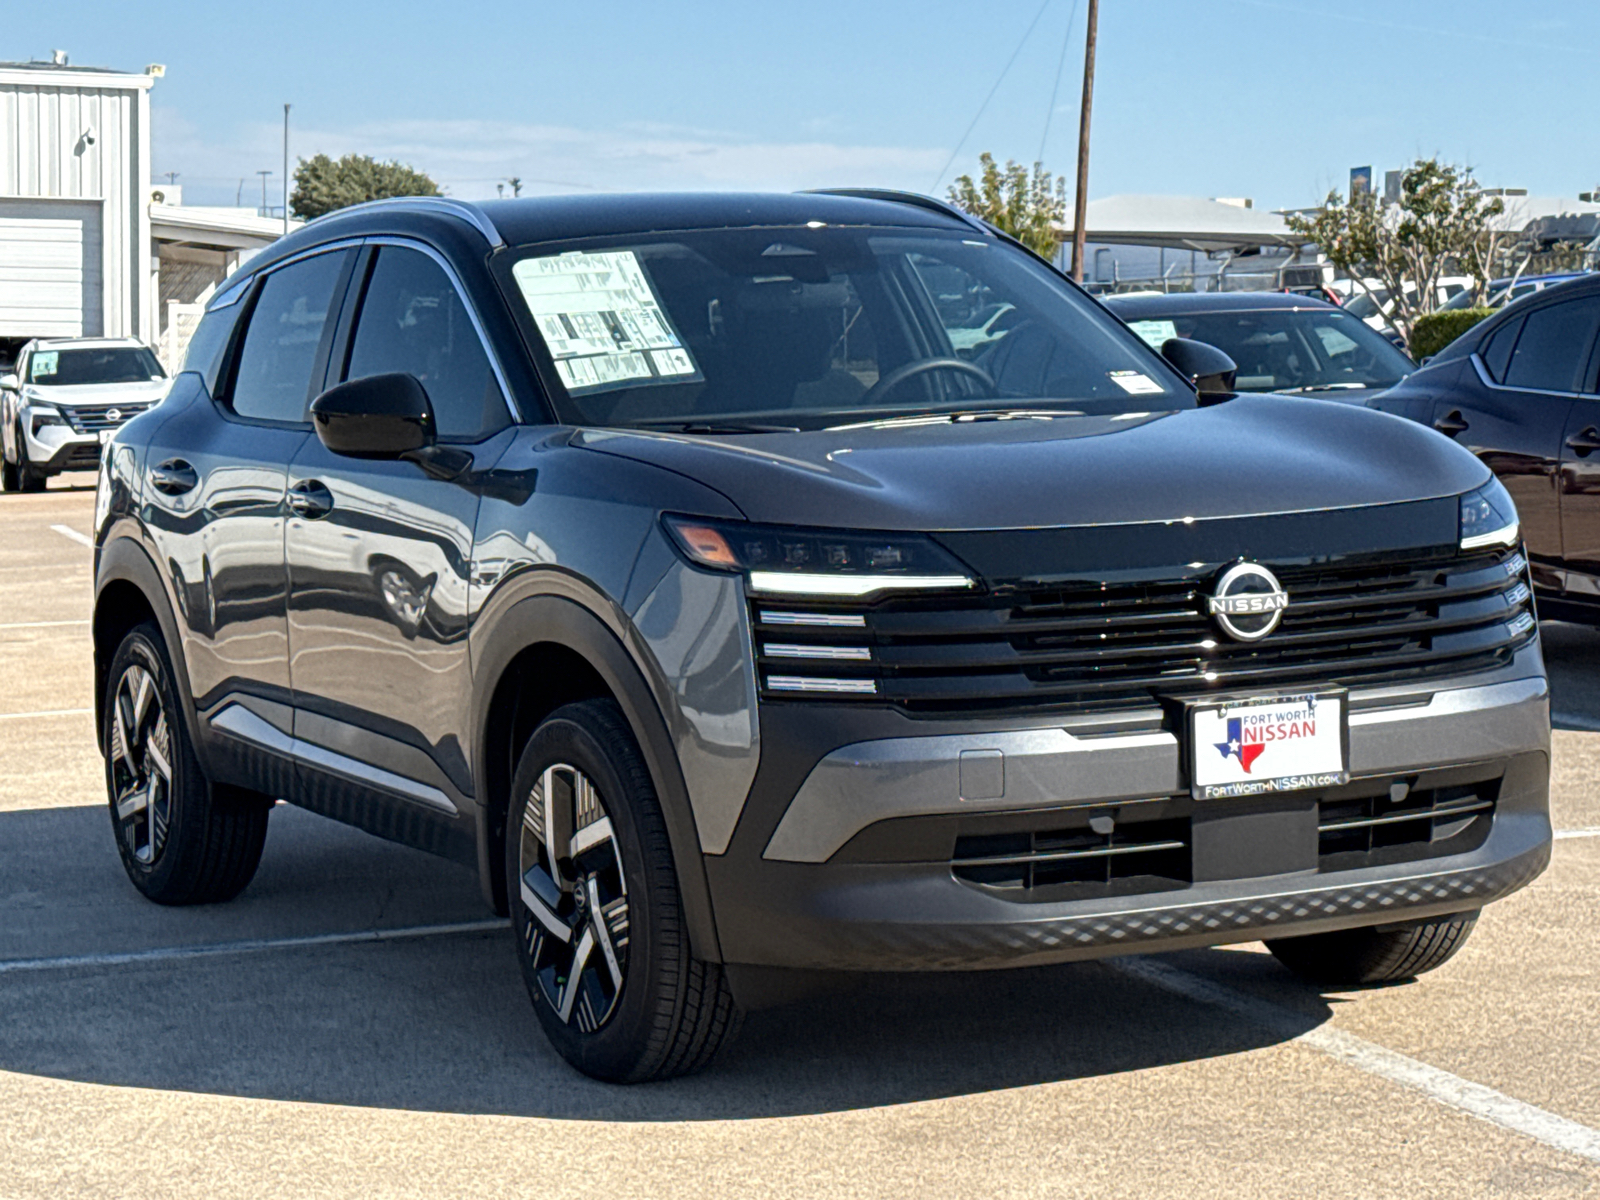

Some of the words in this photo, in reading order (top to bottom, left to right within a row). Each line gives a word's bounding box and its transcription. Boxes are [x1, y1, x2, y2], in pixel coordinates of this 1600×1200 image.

[1211, 595, 1287, 611] NISSAN
[1243, 713, 1272, 725] FORT
[1276, 709, 1316, 722] WORTH
[1243, 720, 1316, 743] NISSAN
